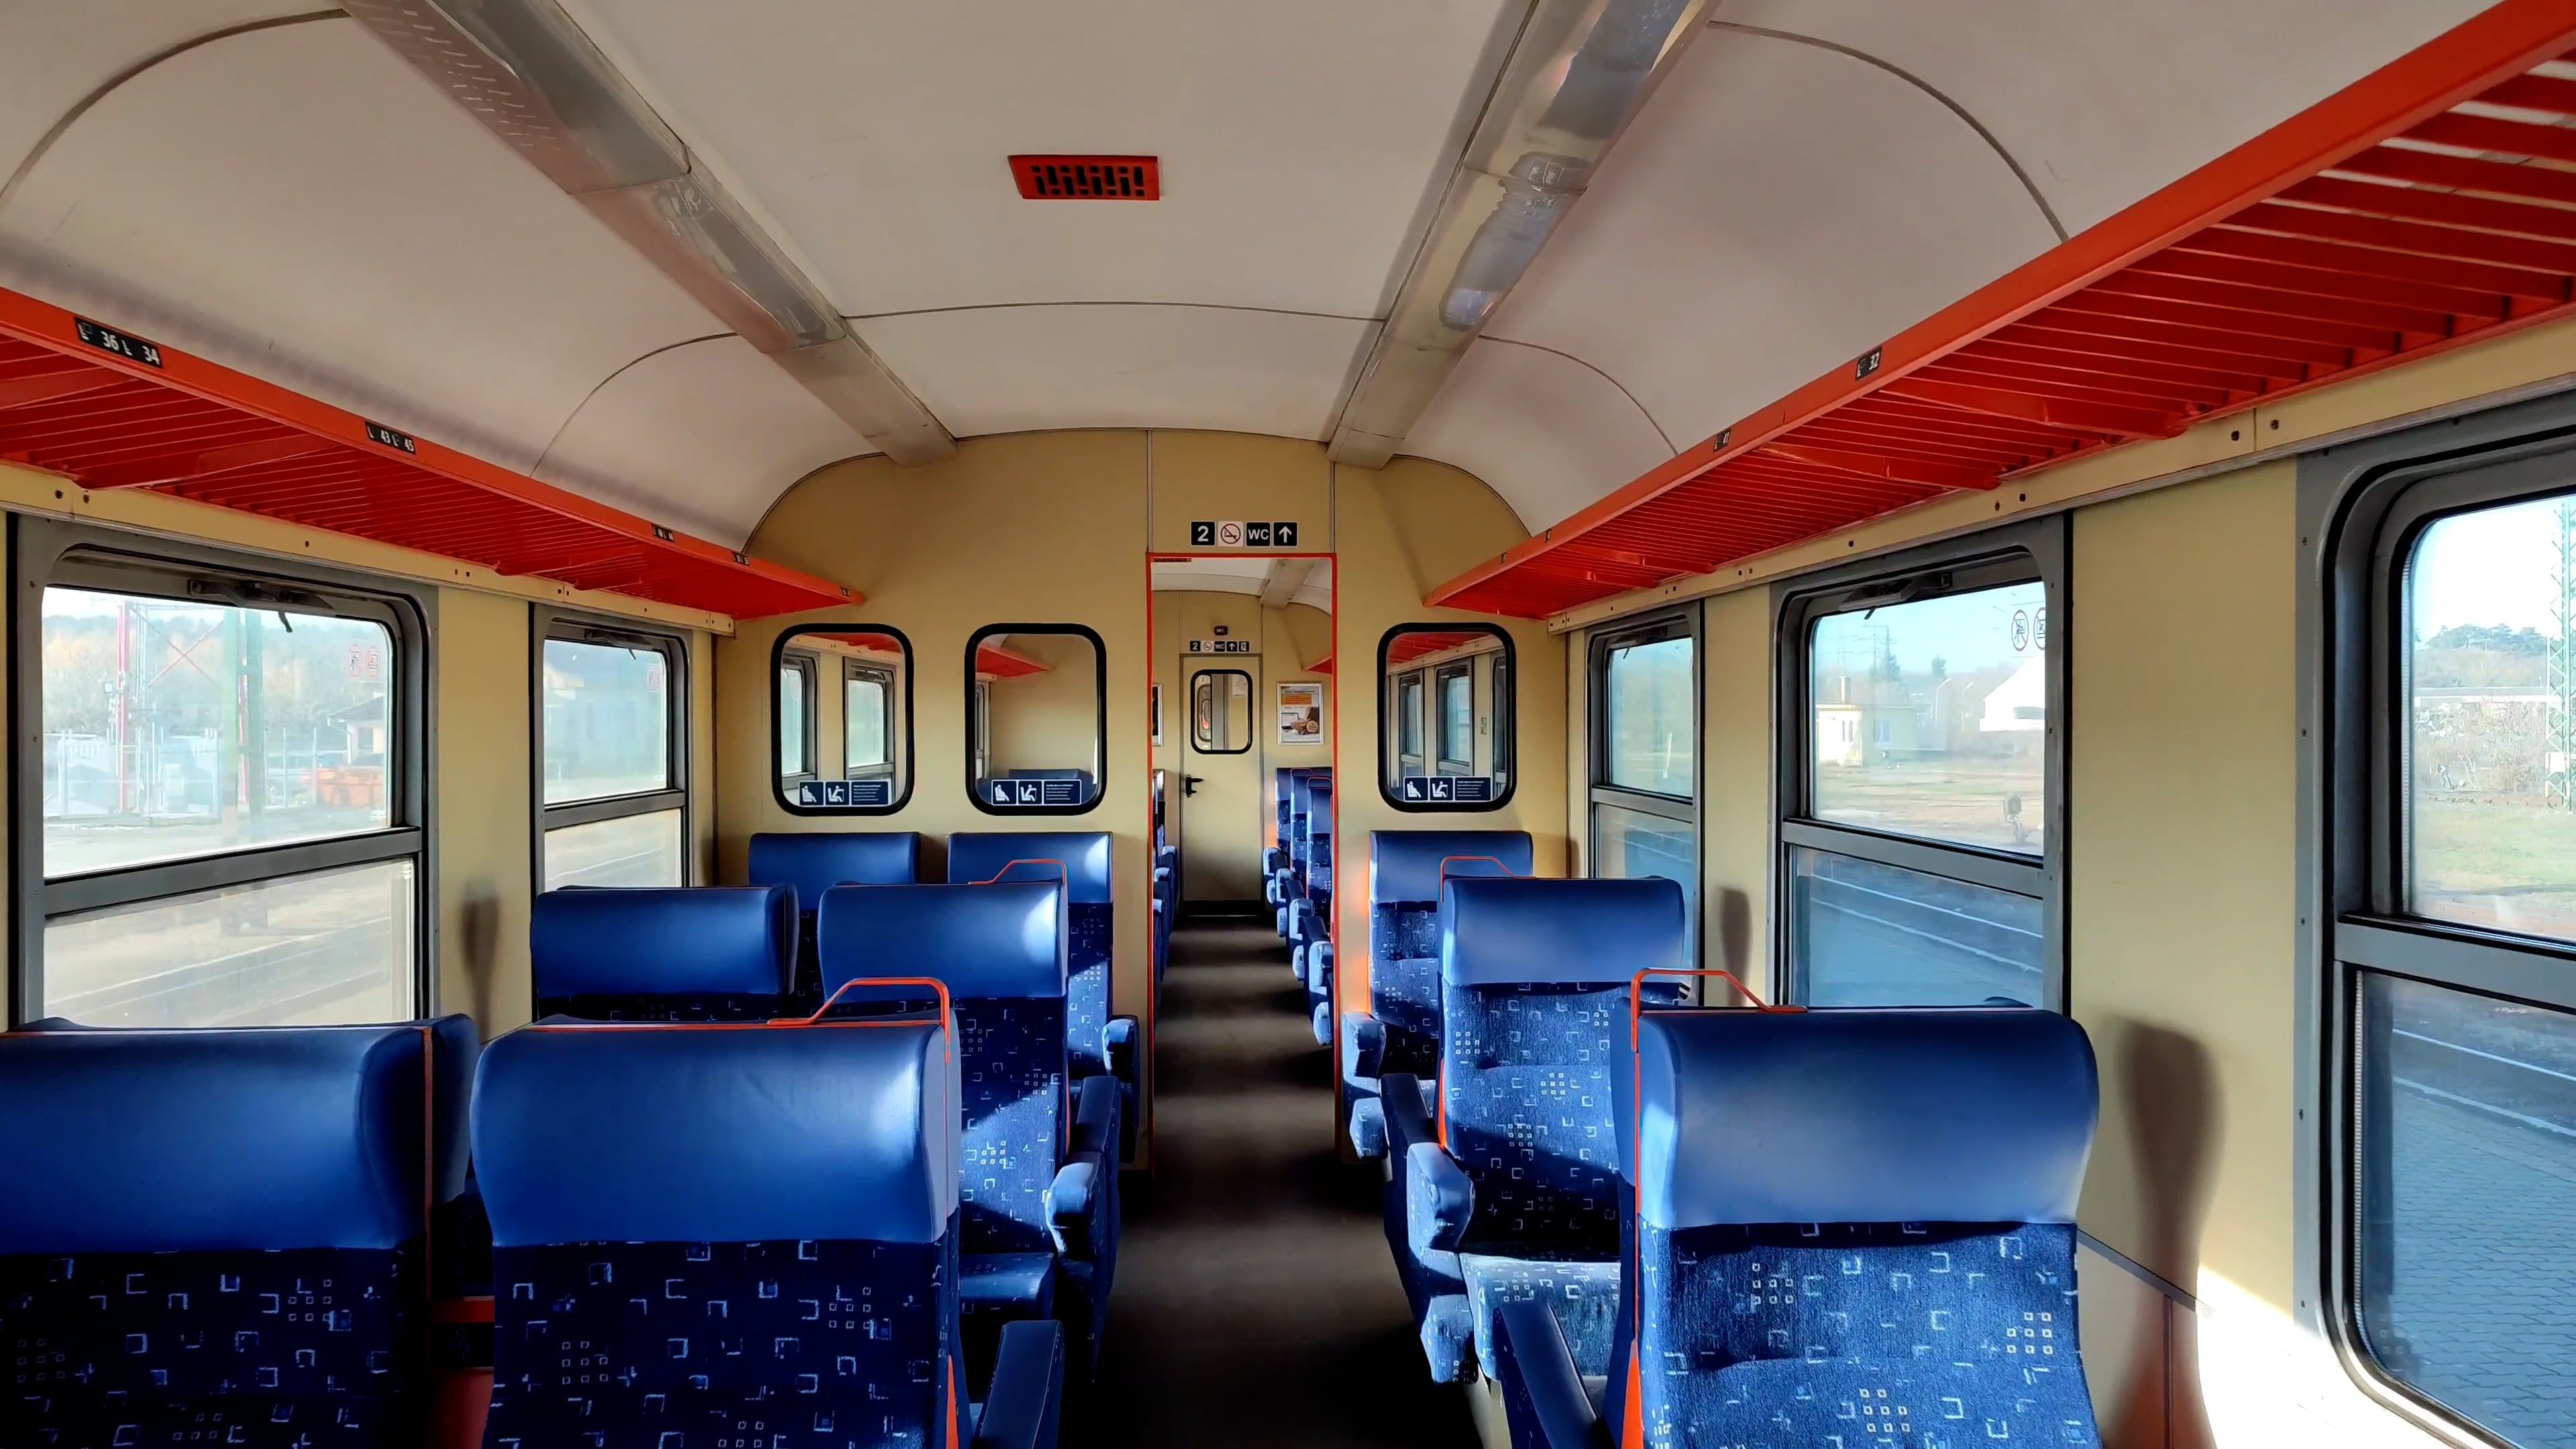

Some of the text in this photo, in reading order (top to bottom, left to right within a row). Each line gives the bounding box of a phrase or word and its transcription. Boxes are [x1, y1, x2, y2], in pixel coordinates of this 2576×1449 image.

[100, 331, 160, 365] 36 34
[1868, 352, 1880, 370] 32
[380, 429, 415, 452] 43 45
[1197, 525, 1269, 542] 2 WC
[1192, 642, 1198, 651] 2
